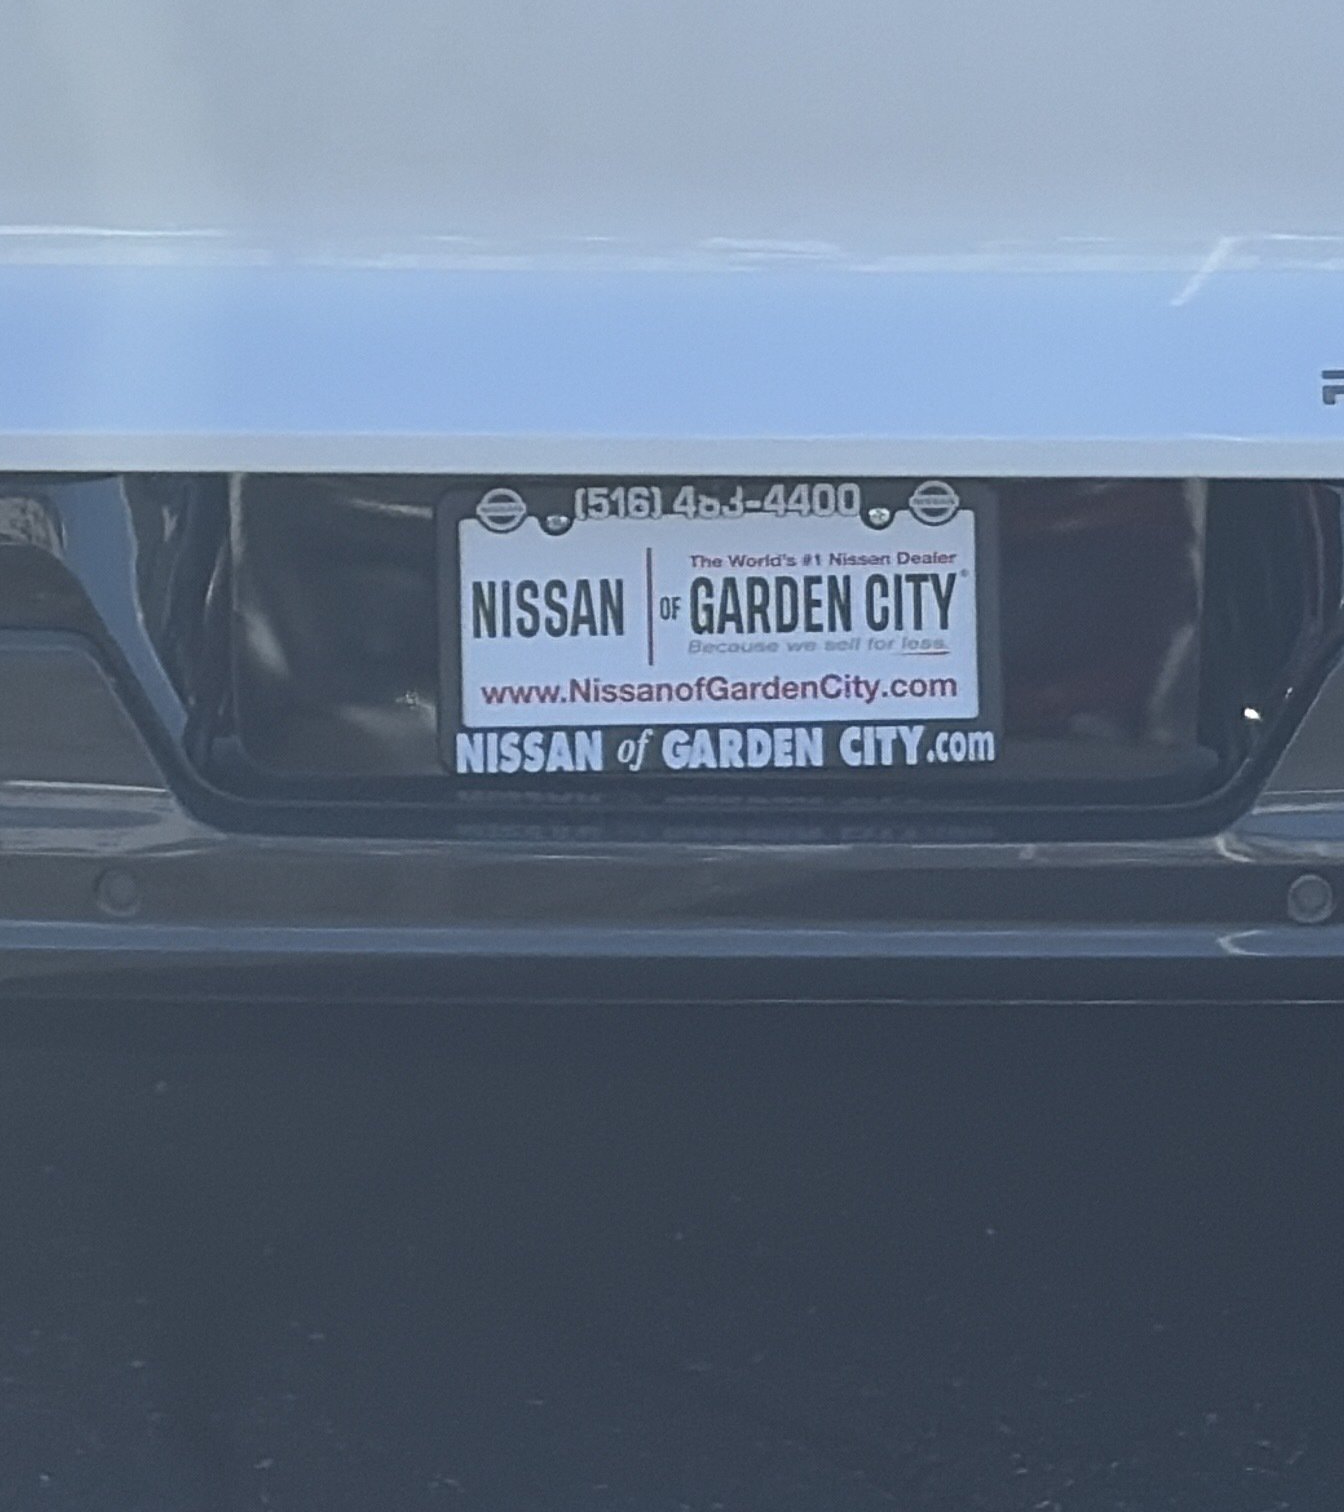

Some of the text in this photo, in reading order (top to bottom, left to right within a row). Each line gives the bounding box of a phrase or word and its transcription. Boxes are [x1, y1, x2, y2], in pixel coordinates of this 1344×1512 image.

[574, 486, 663, 521] (516)
[689, 554, 723, 568] The
[728, 553, 797, 568] World's
[829, 551, 891, 566] Nissan
[896, 550, 958, 565] Dealer
[472, 578, 624, 638] NISSAN
[659, 572, 958, 634] OF GARDEN CITY
[688, 639, 779, 655] Because
[786, 639, 816, 652] we
[867, 635, 895, 651] for
[480, 673, 957, 704] www.NissanofGardenCity.com
[456, 725, 995, 774] NISSAN of GARDEN CITY.com
